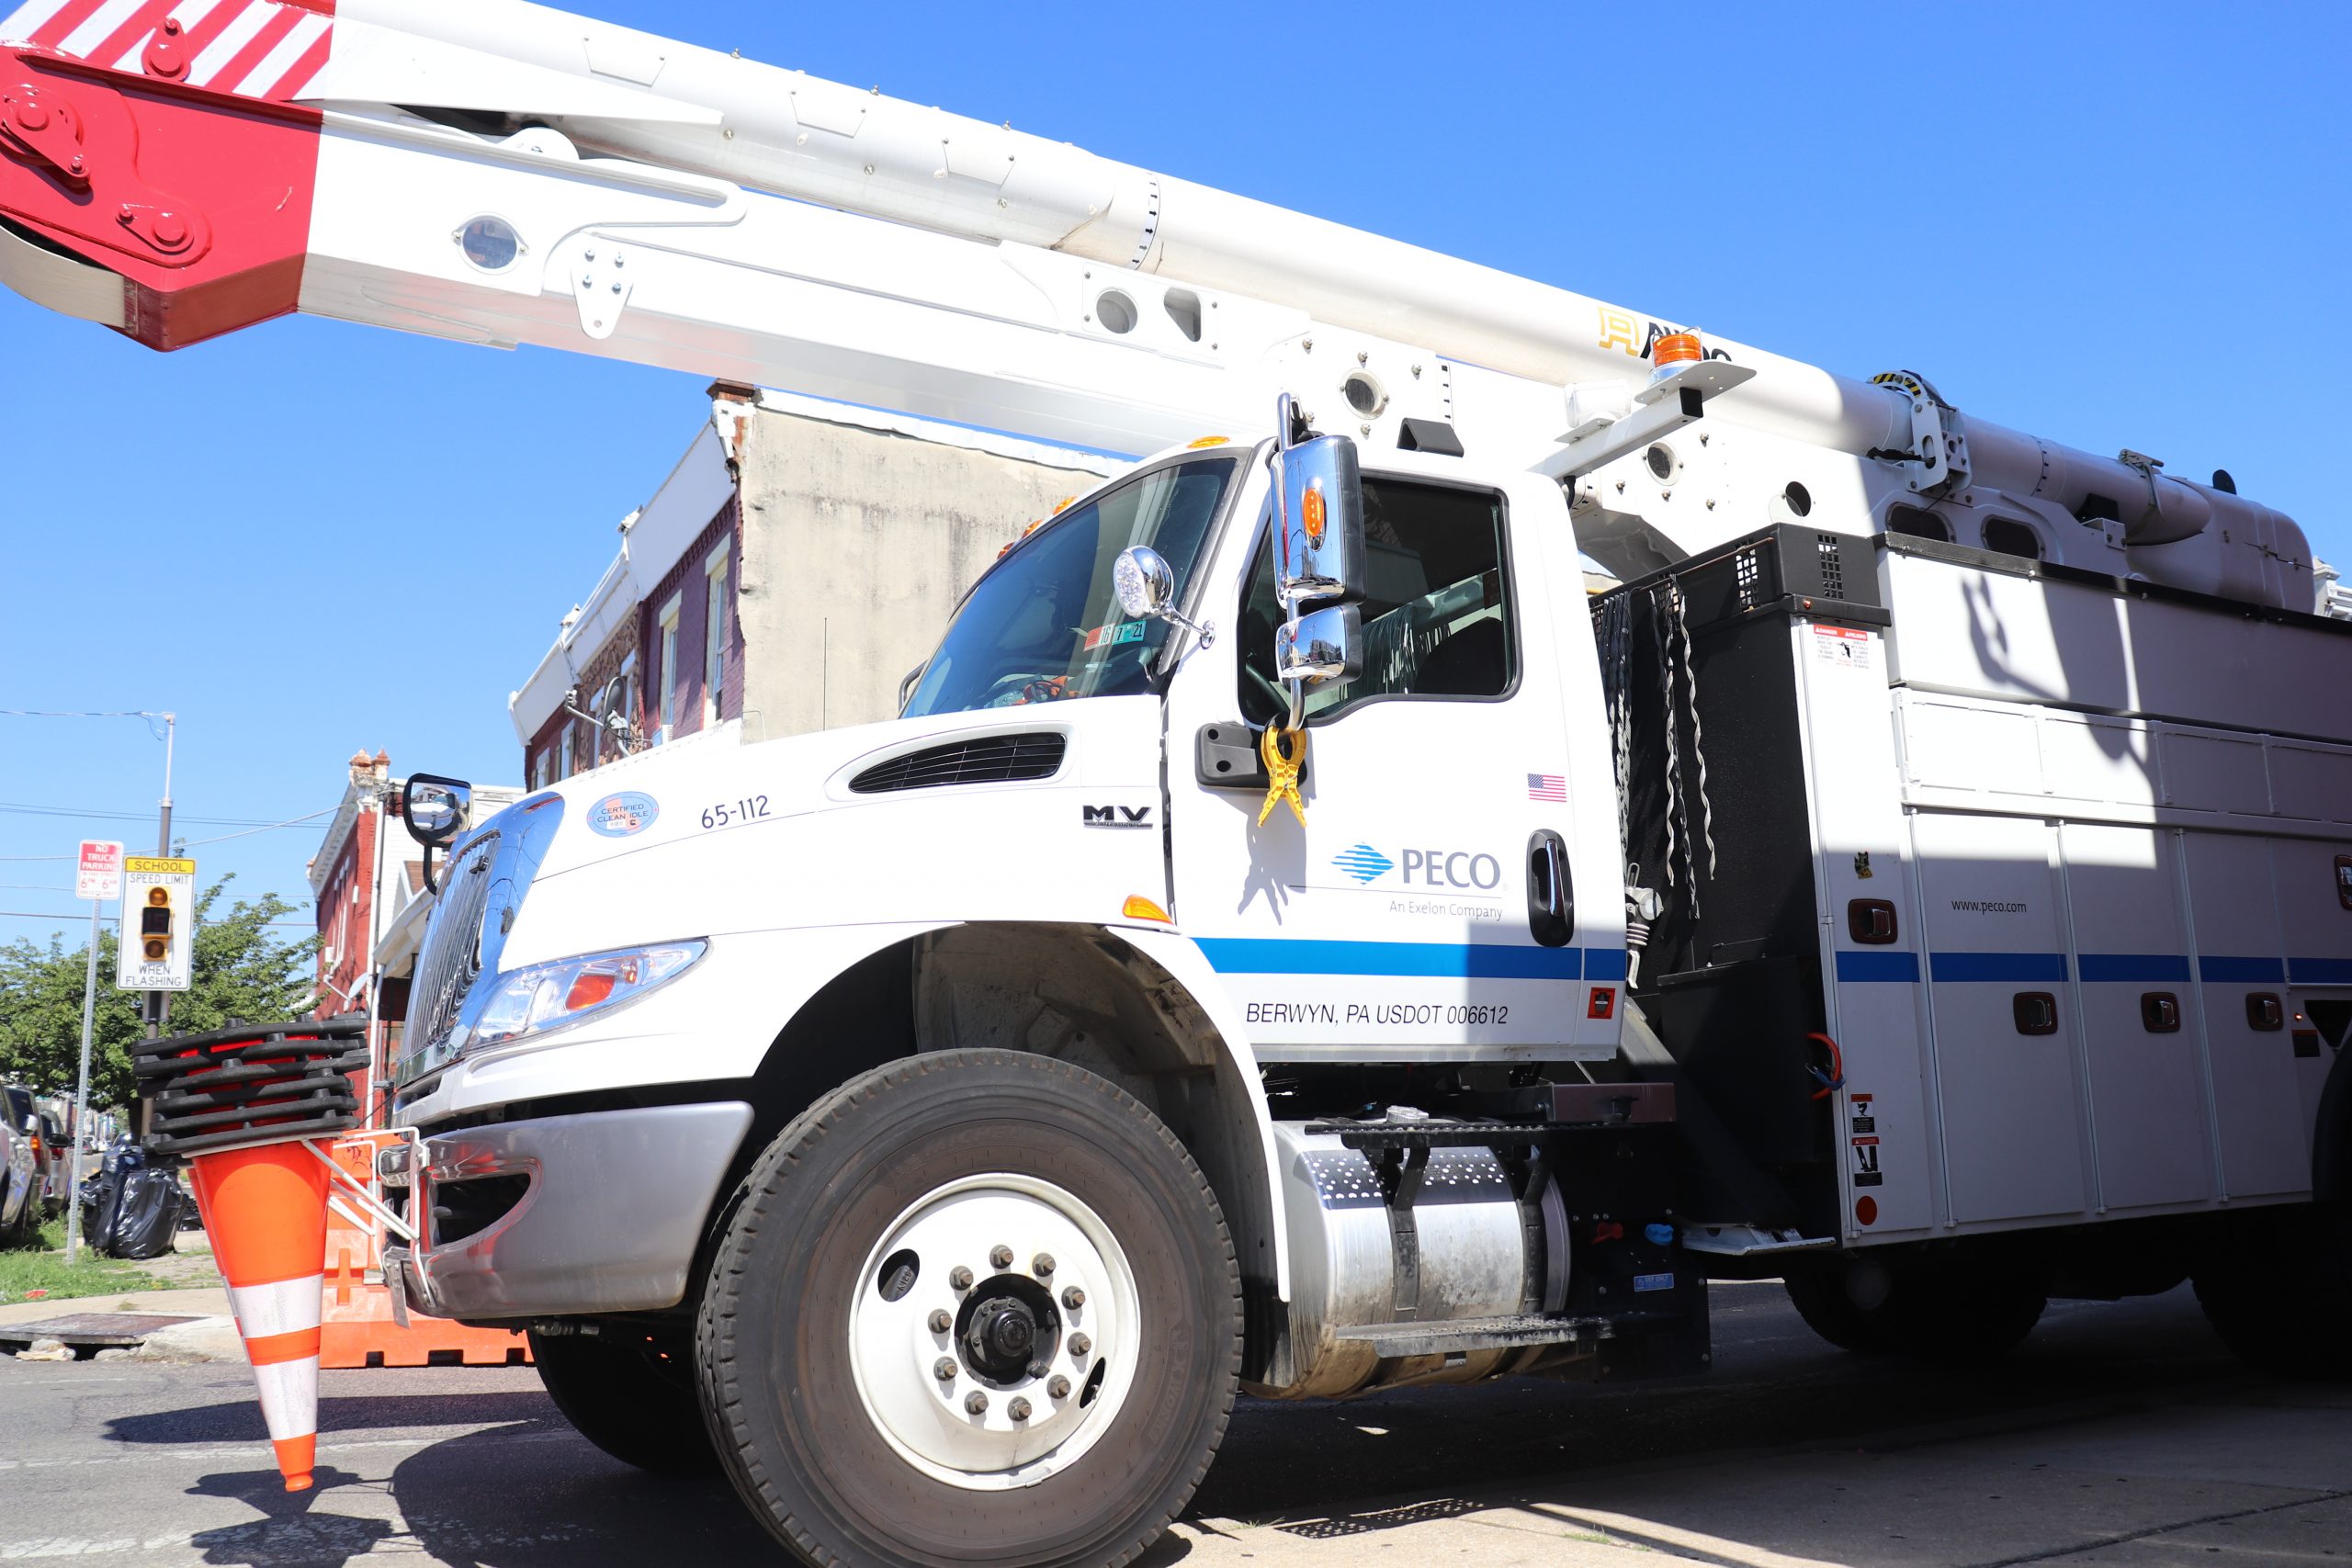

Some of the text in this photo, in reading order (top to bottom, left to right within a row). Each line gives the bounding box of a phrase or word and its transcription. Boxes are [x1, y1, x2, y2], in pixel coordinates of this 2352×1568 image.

[601, 804, 645, 815] CERTIFIED
[701, 795, 771, 829] 65-112
[1082, 805, 1152, 823] MV
[596, 814, 627, 823] CLEAN
[96, 844, 108, 853] NO
[87, 853, 117, 862] TRUCK
[82, 862, 119, 871] PARKING
[134, 861, 187, 873] SCHOOL
[1401, 848, 1501, 890] PECO
[130, 874, 189, 885] SPEED LIMIT
[1390, 900, 1503, 921] An Exelon Company
[1951, 900, 2028, 916] www.peco.com
[139, 964, 171, 976] WHEN
[125, 976, 182, 987] FLASHING
[1246, 1002, 1509, 1027] BERWYN, PA USDOT 006612
